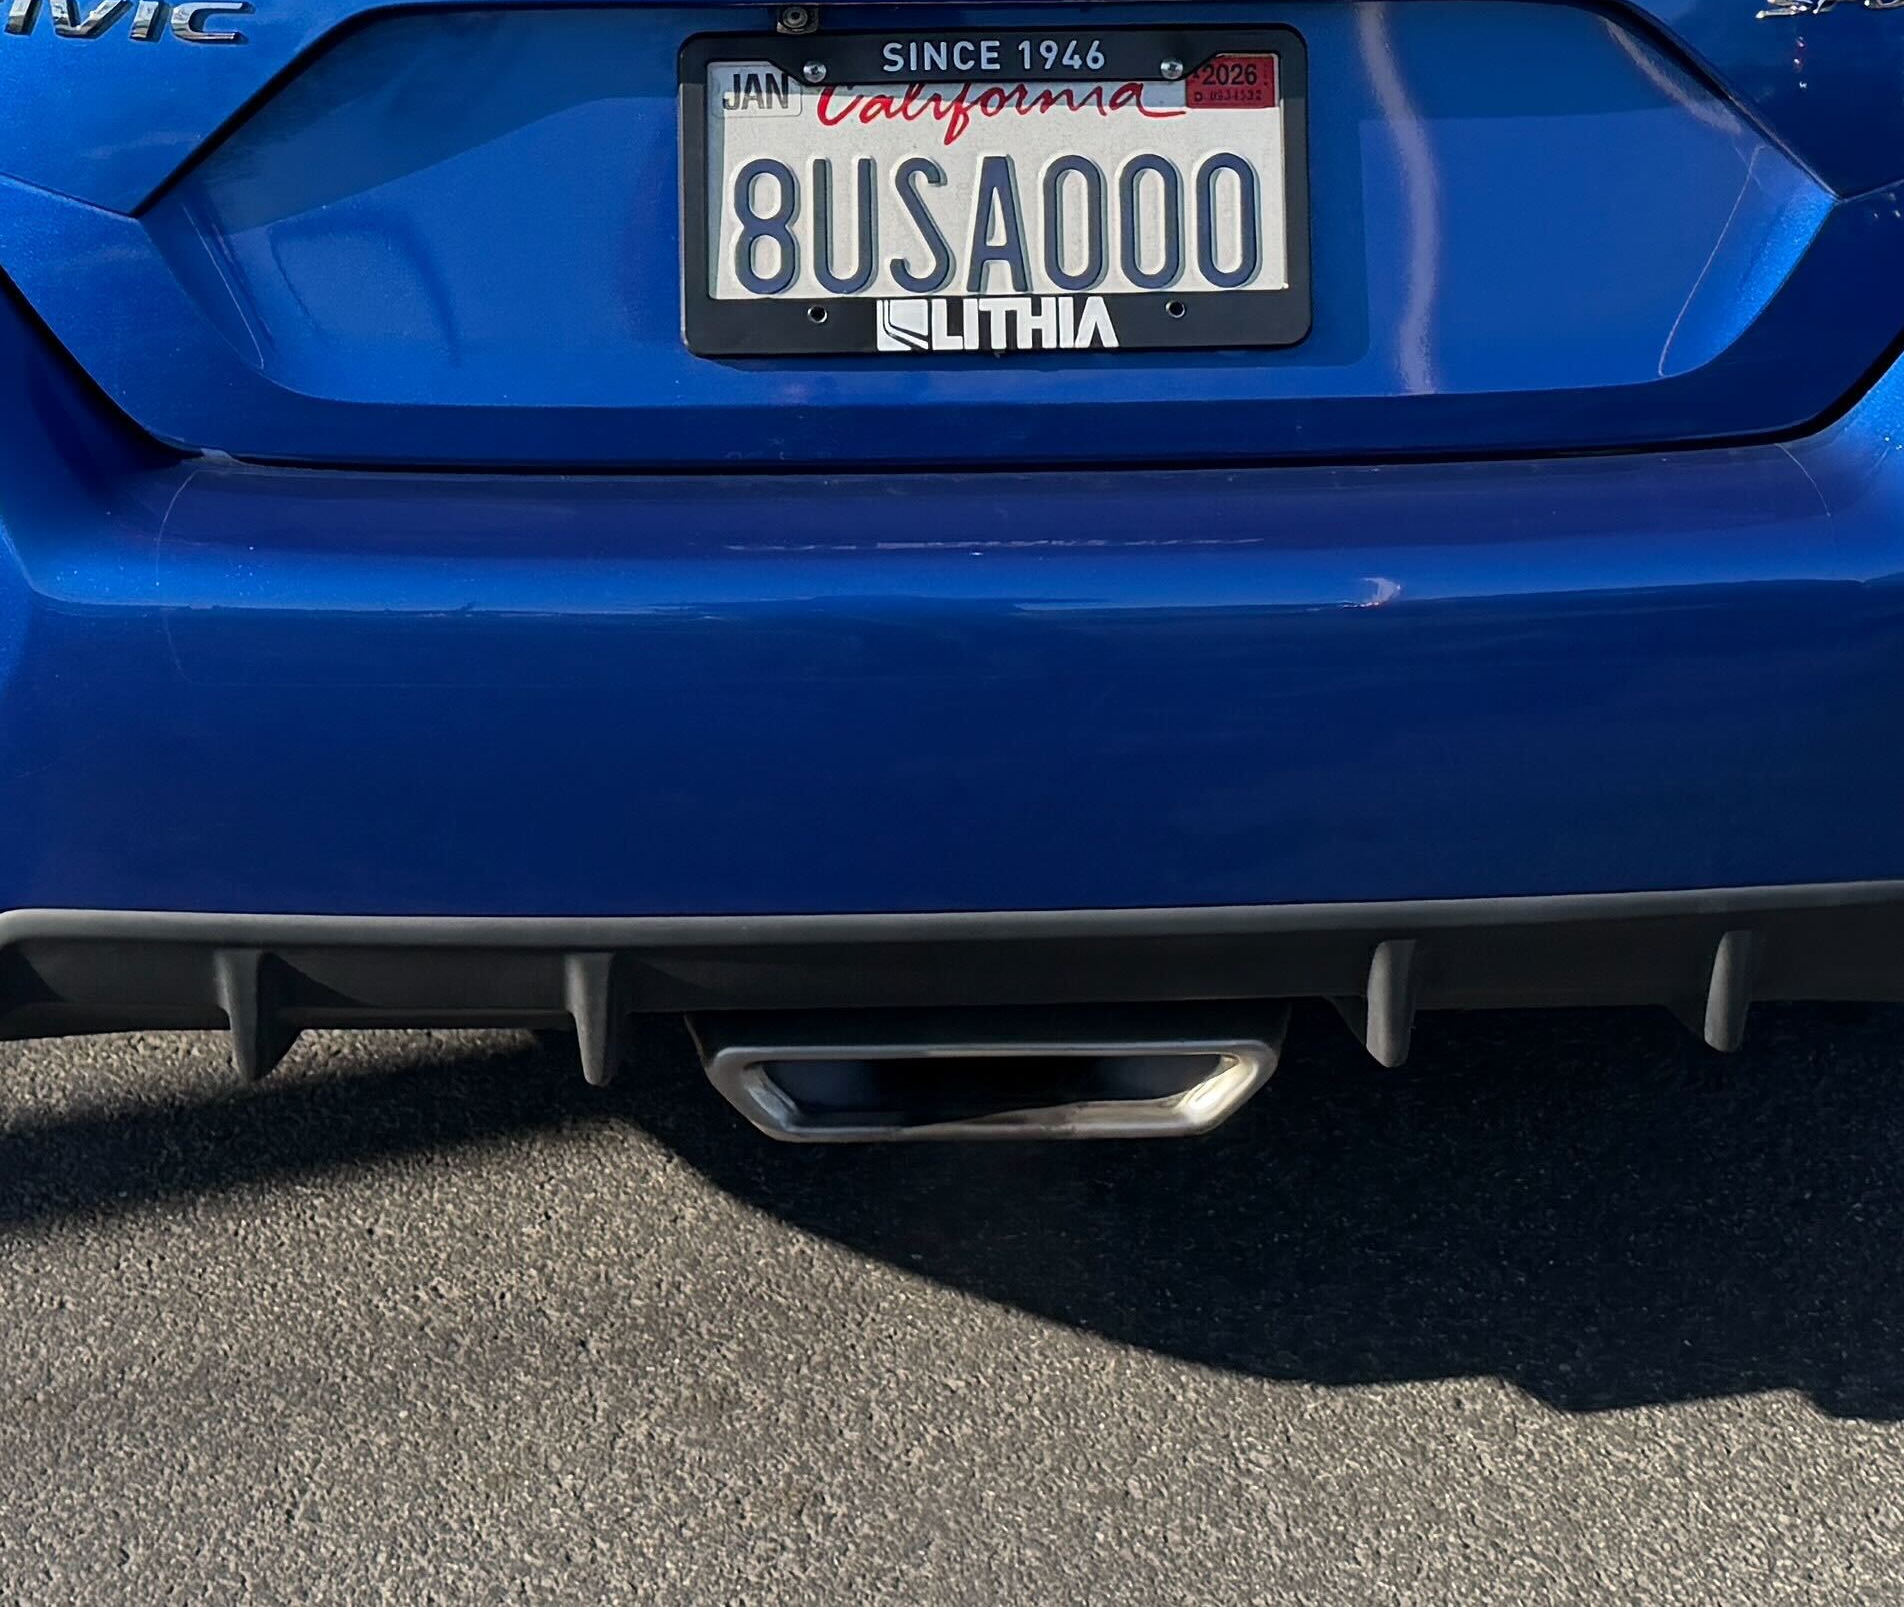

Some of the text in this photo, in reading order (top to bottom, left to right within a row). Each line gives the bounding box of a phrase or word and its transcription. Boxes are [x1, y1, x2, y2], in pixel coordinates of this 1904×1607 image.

[882, 39, 1106, 72] SINCE 1946
[1202, 63, 1258, 86] 2026
[722, 72, 790, 111] JAN
[816, 82, 1187, 146] California
[733, 152, 1257, 294] 8USA000
[931, 295, 1120, 351] LITHIA
